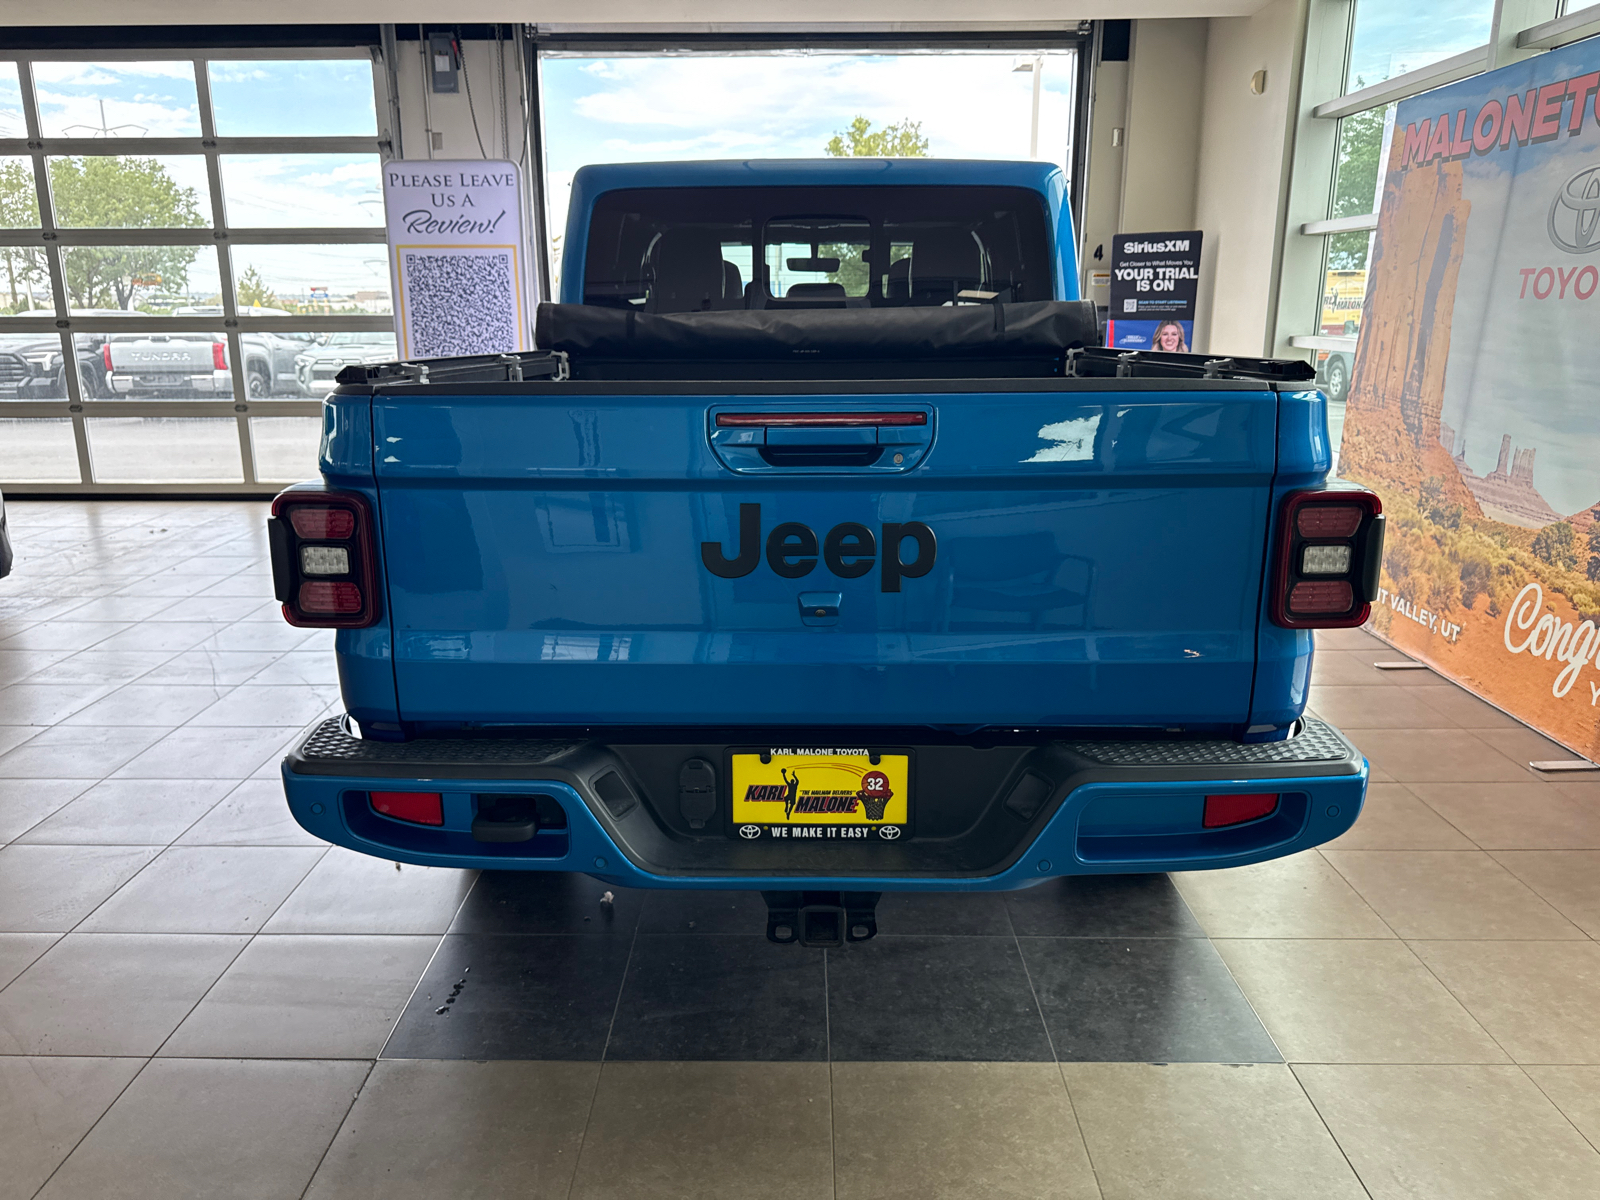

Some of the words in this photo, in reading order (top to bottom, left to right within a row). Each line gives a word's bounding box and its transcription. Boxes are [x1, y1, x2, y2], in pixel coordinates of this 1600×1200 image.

[1402, 72, 1600, 171] MALONET
[389, 172, 453, 187] PLEASE
[460, 172, 515, 187] LEAVE
[461, 193, 476, 207] A
[402, 209, 506, 234] Review!
[1093, 244, 1104, 261] 4
[1123, 240, 1190, 254] SiriusXM
[1115, 268, 1154, 281] YOUR
[1156, 267, 1198, 280] TRIAL
[1136, 280, 1150, 292] IS
[1152, 280, 1175, 291] ON
[1519, 265, 1599, 300] TOYO
[131, 351, 192, 361] TUNDRA
[701, 503, 937, 593] Jeep
[1390, 593, 1437, 635] VALLEY,
[1441, 619, 1461, 642] UT
[770, 748, 795, 756] KARL
[796, 748, 833, 756] MALONE
[835, 748, 869, 756] TOYOTA
[867, 778, 884, 791] 32
[744, 785, 788, 802] KARL
[794, 796, 859, 813] MALONE
[771, 827, 788, 838] WE
[792, 827, 823, 838] MAKE
[827, 827, 837, 838] IT
[841, 827, 869, 838] EASY
